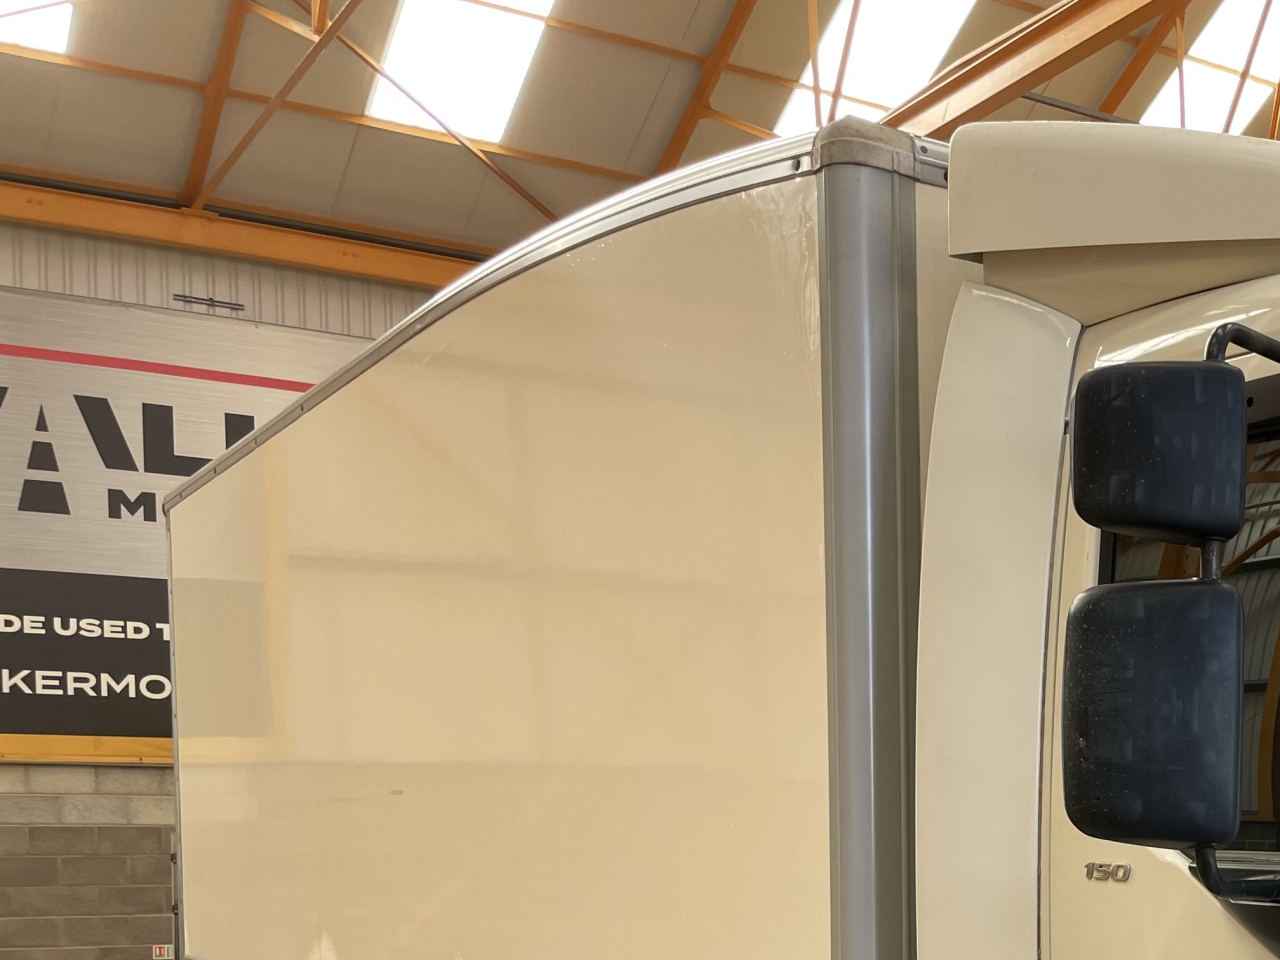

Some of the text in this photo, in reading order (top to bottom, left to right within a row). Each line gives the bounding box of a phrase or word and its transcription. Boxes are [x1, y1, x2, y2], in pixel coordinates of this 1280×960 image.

[53, 617, 150, 640] USED
[1, 668, 172, 700] KERMO
[1084, 861, 1132, 882] 150
